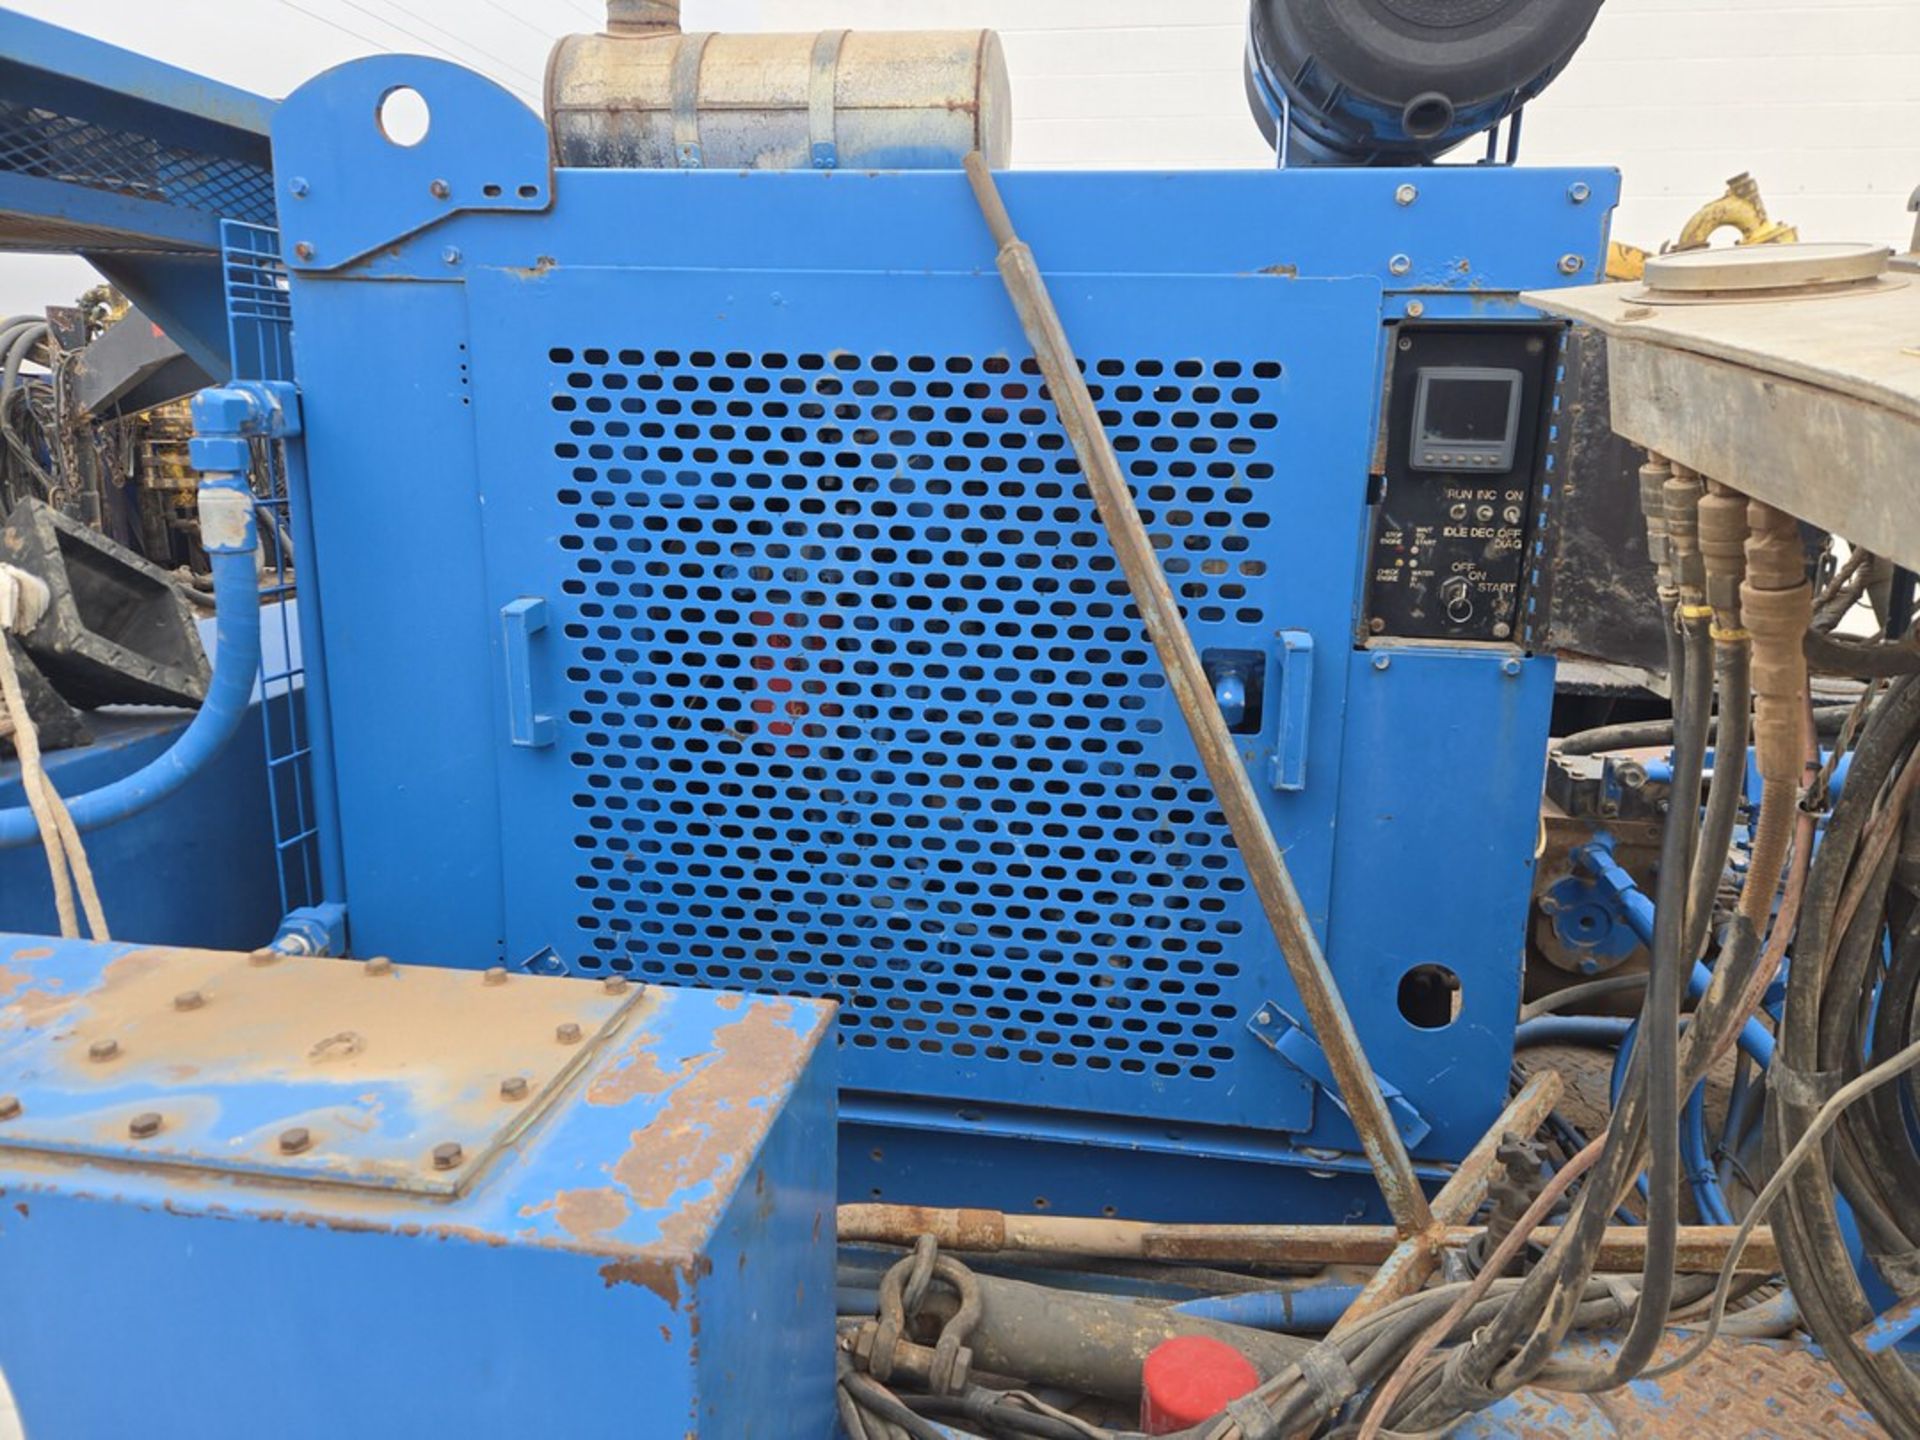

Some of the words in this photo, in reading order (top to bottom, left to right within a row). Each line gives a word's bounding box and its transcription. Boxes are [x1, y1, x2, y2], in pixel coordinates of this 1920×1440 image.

[1447, 489, 1472, 499] RUN
[1477, 490, 1497, 500] INC
[1505, 490, 1524, 501] ON
[1443, 528, 1468, 537] IDLE
[1470, 528, 1494, 538] DEC
[1497, 529, 1522, 538] OFF
[1494, 540, 1522, 549] DIAG
[1451, 562, 1476, 572] OFF
[1468, 571, 1487, 581] ON
[1477, 583, 1517, 592] START
